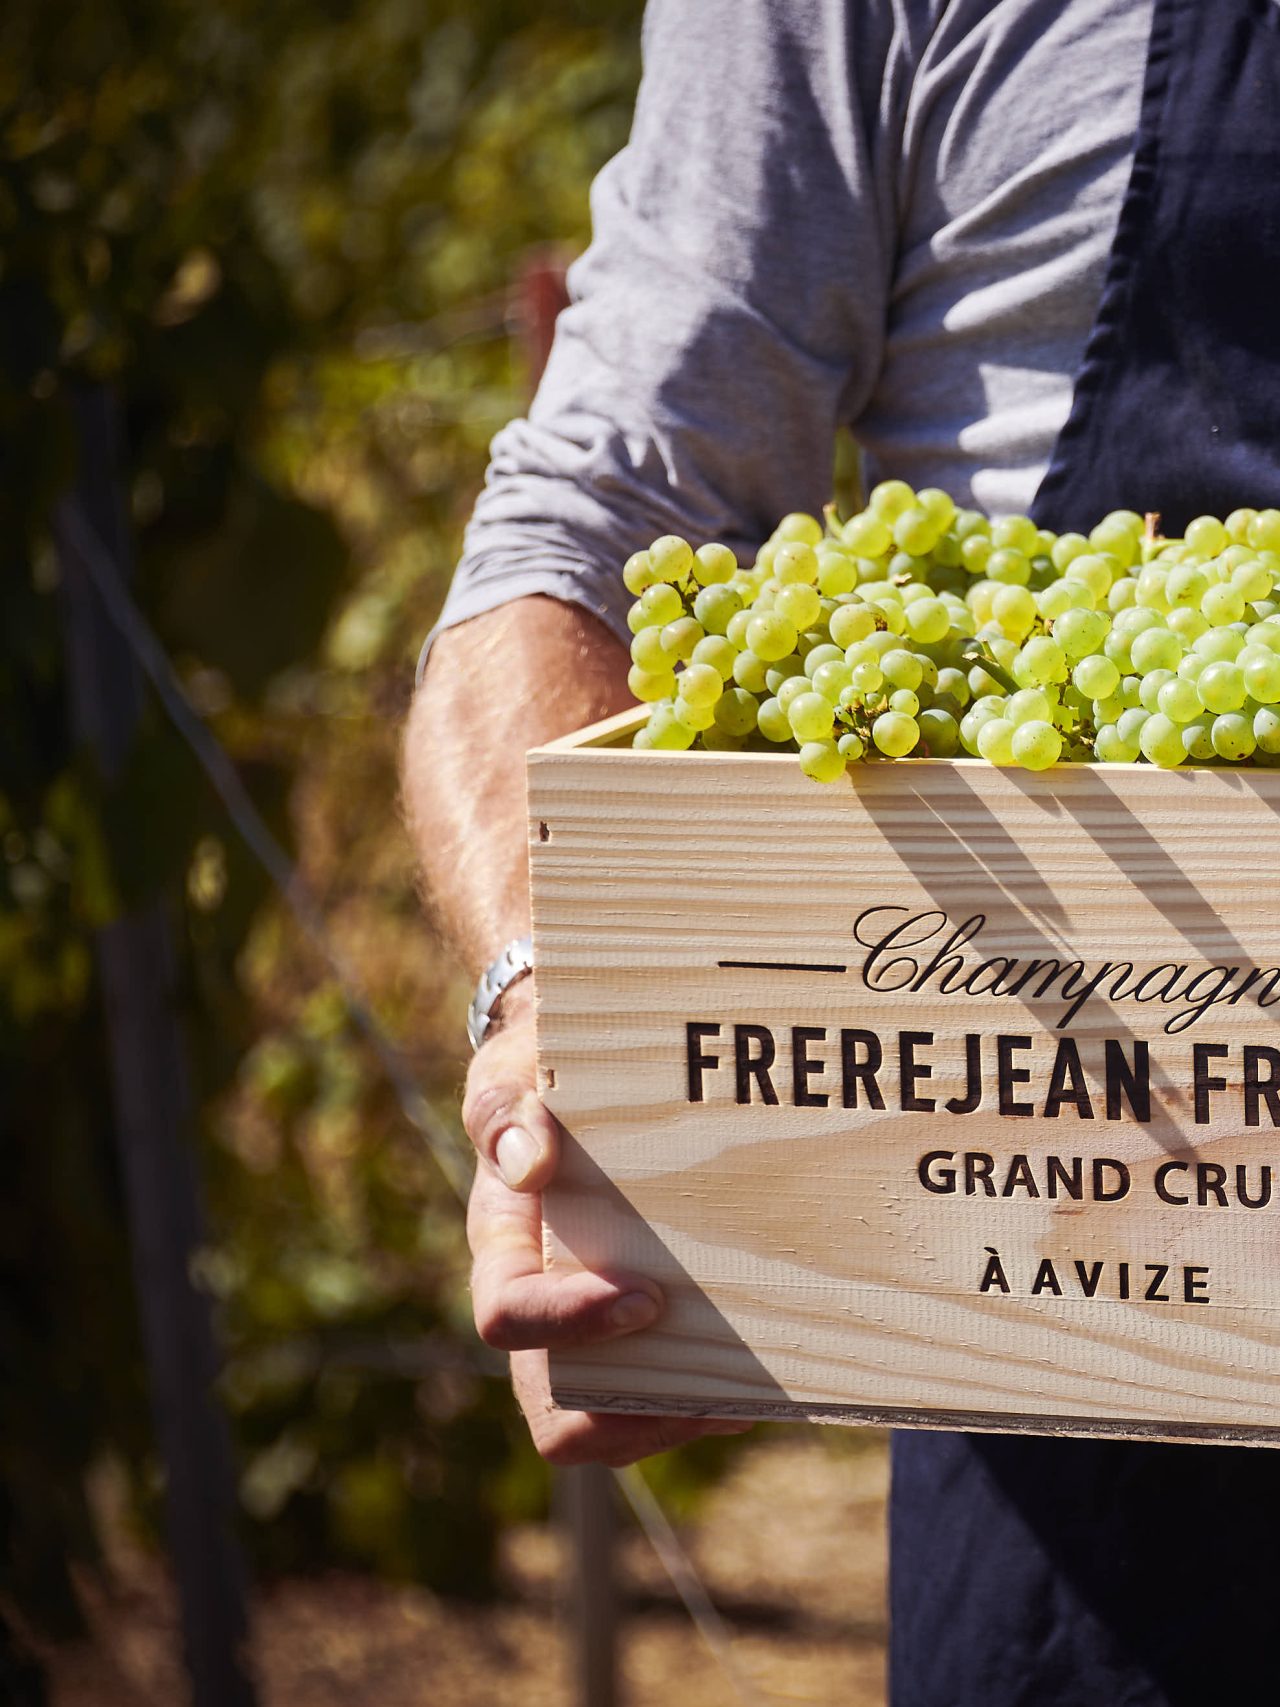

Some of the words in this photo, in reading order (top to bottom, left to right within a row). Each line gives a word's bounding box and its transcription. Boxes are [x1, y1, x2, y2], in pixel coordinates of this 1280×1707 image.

[687, 1021, 1151, 1122] FREREJEAN
[918, 1151, 1130, 1201] GRAND
[1155, 1161, 1271, 1208] CRU
[980, 1247, 1010, 1292] À
[1032, 1259, 1209, 1303] AVIZE
